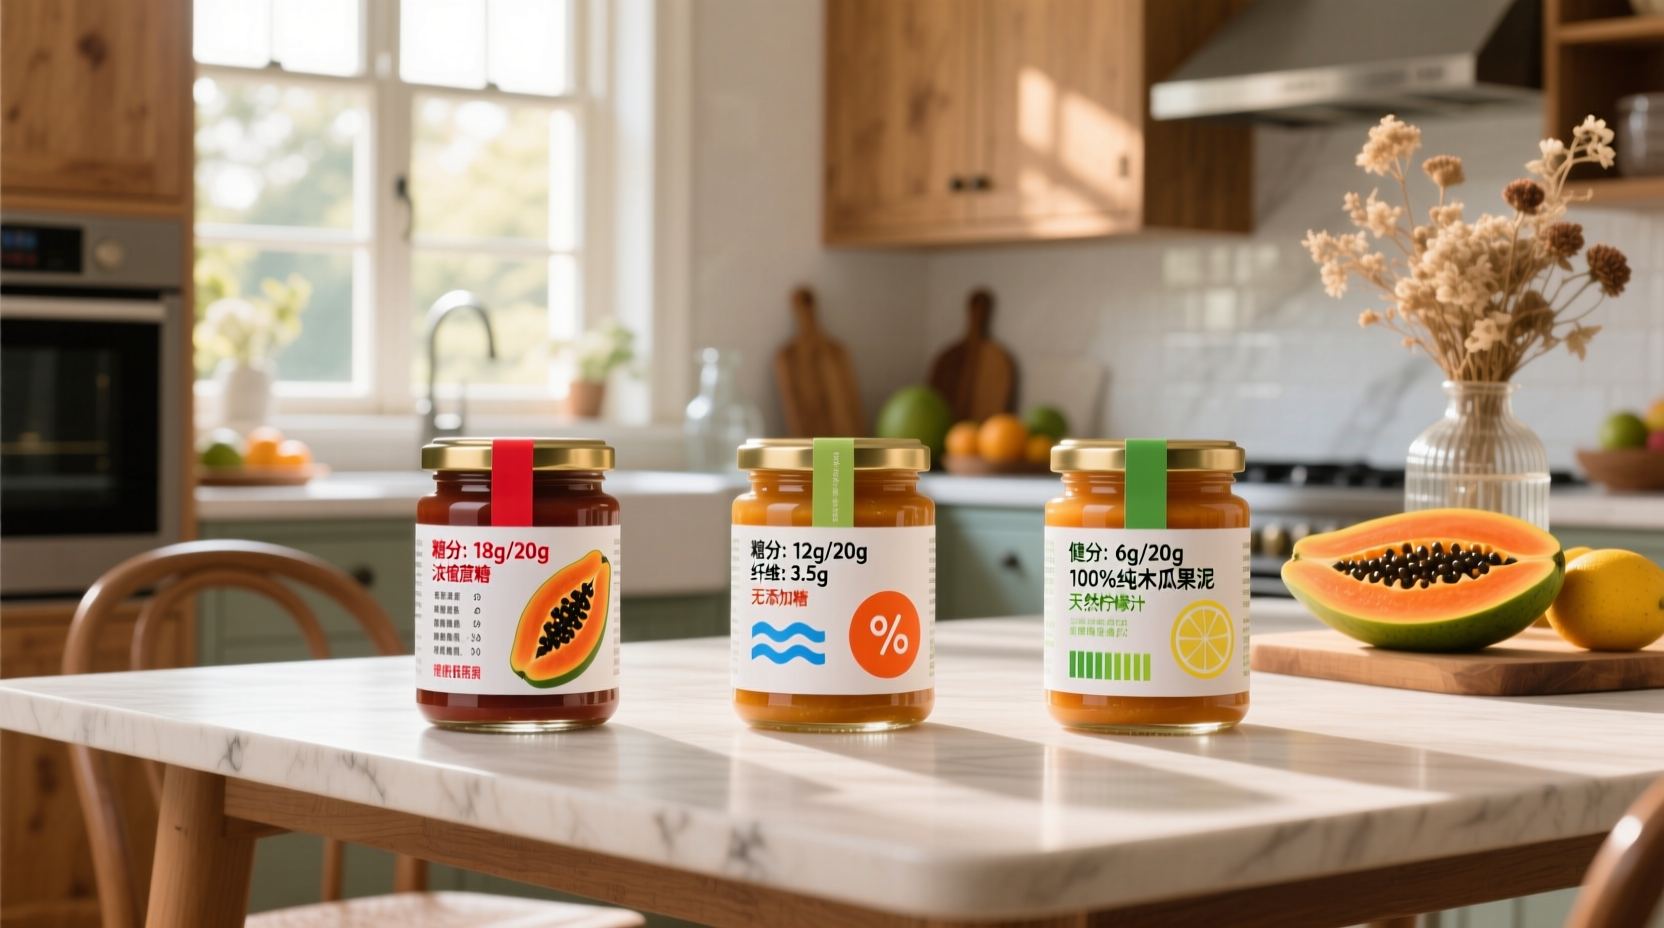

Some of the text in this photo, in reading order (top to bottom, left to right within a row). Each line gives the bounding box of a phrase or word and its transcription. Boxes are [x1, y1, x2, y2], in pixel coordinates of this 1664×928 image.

[473, 541, 549, 564] 18g/20g
[793, 541, 868, 565] 12g/20g
[1115, 543, 1184, 566] 6g/20g
[790, 565, 828, 587] 3.5g
[1069, 567, 1215, 591] 100%纯木瓜果泥
[869, 613, 909, 656] %
